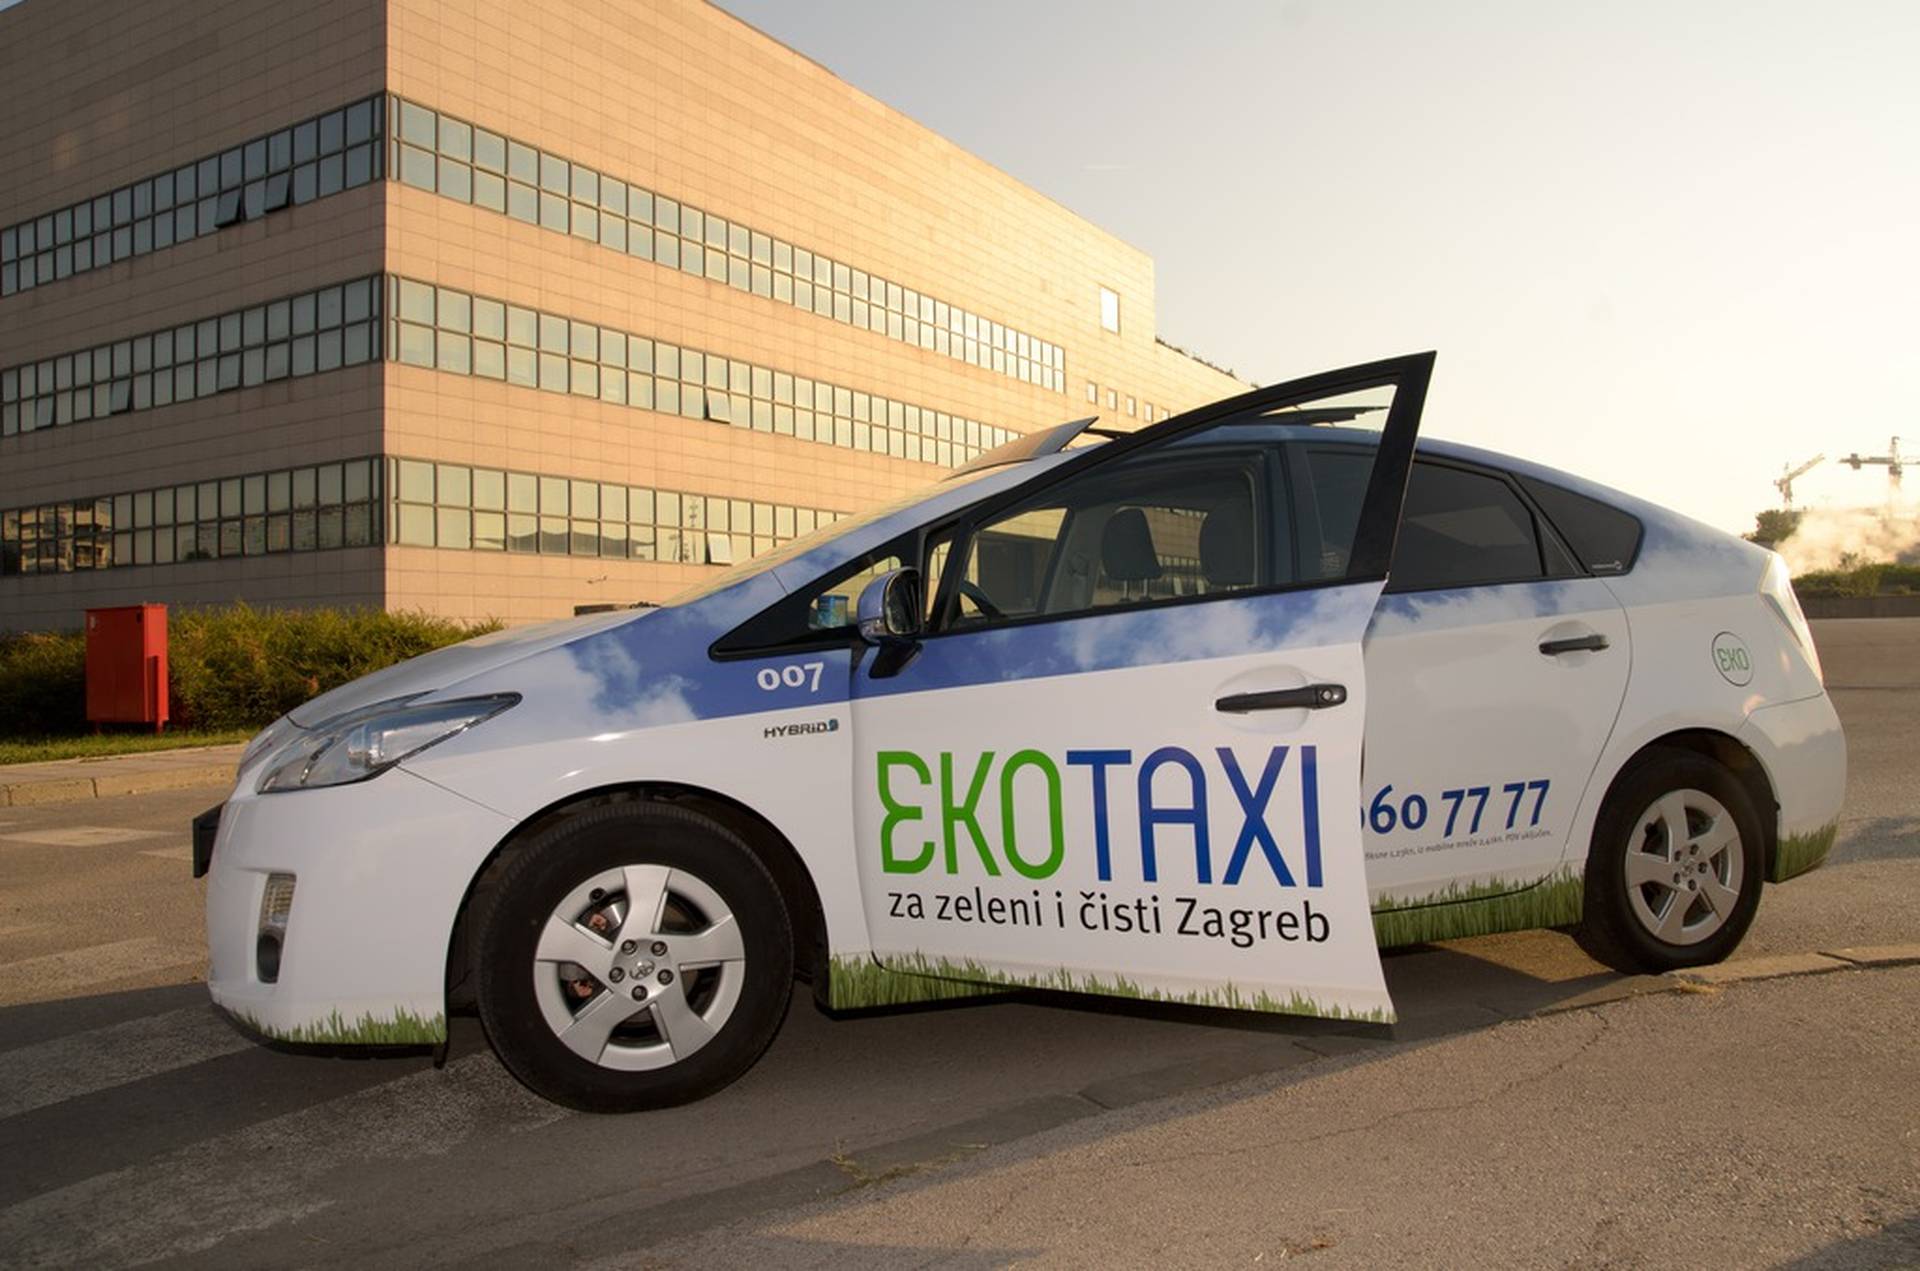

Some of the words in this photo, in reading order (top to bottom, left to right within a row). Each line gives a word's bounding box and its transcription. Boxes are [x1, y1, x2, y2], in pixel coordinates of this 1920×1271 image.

[757, 662, 824, 692] 007
[1717, 647, 1749, 671] EKO
[1361, 784, 1428, 834] 60
[1441, 786, 1490, 838] 77
[1503, 779, 1550, 829] 77
[889, 892, 924, 919] za
[935, 887, 1042, 927] zeleni
[1055, 891, 1065, 928] i
[1079, 891, 1161, 934] čisti
[1175, 898, 1330, 948] Zagreb
